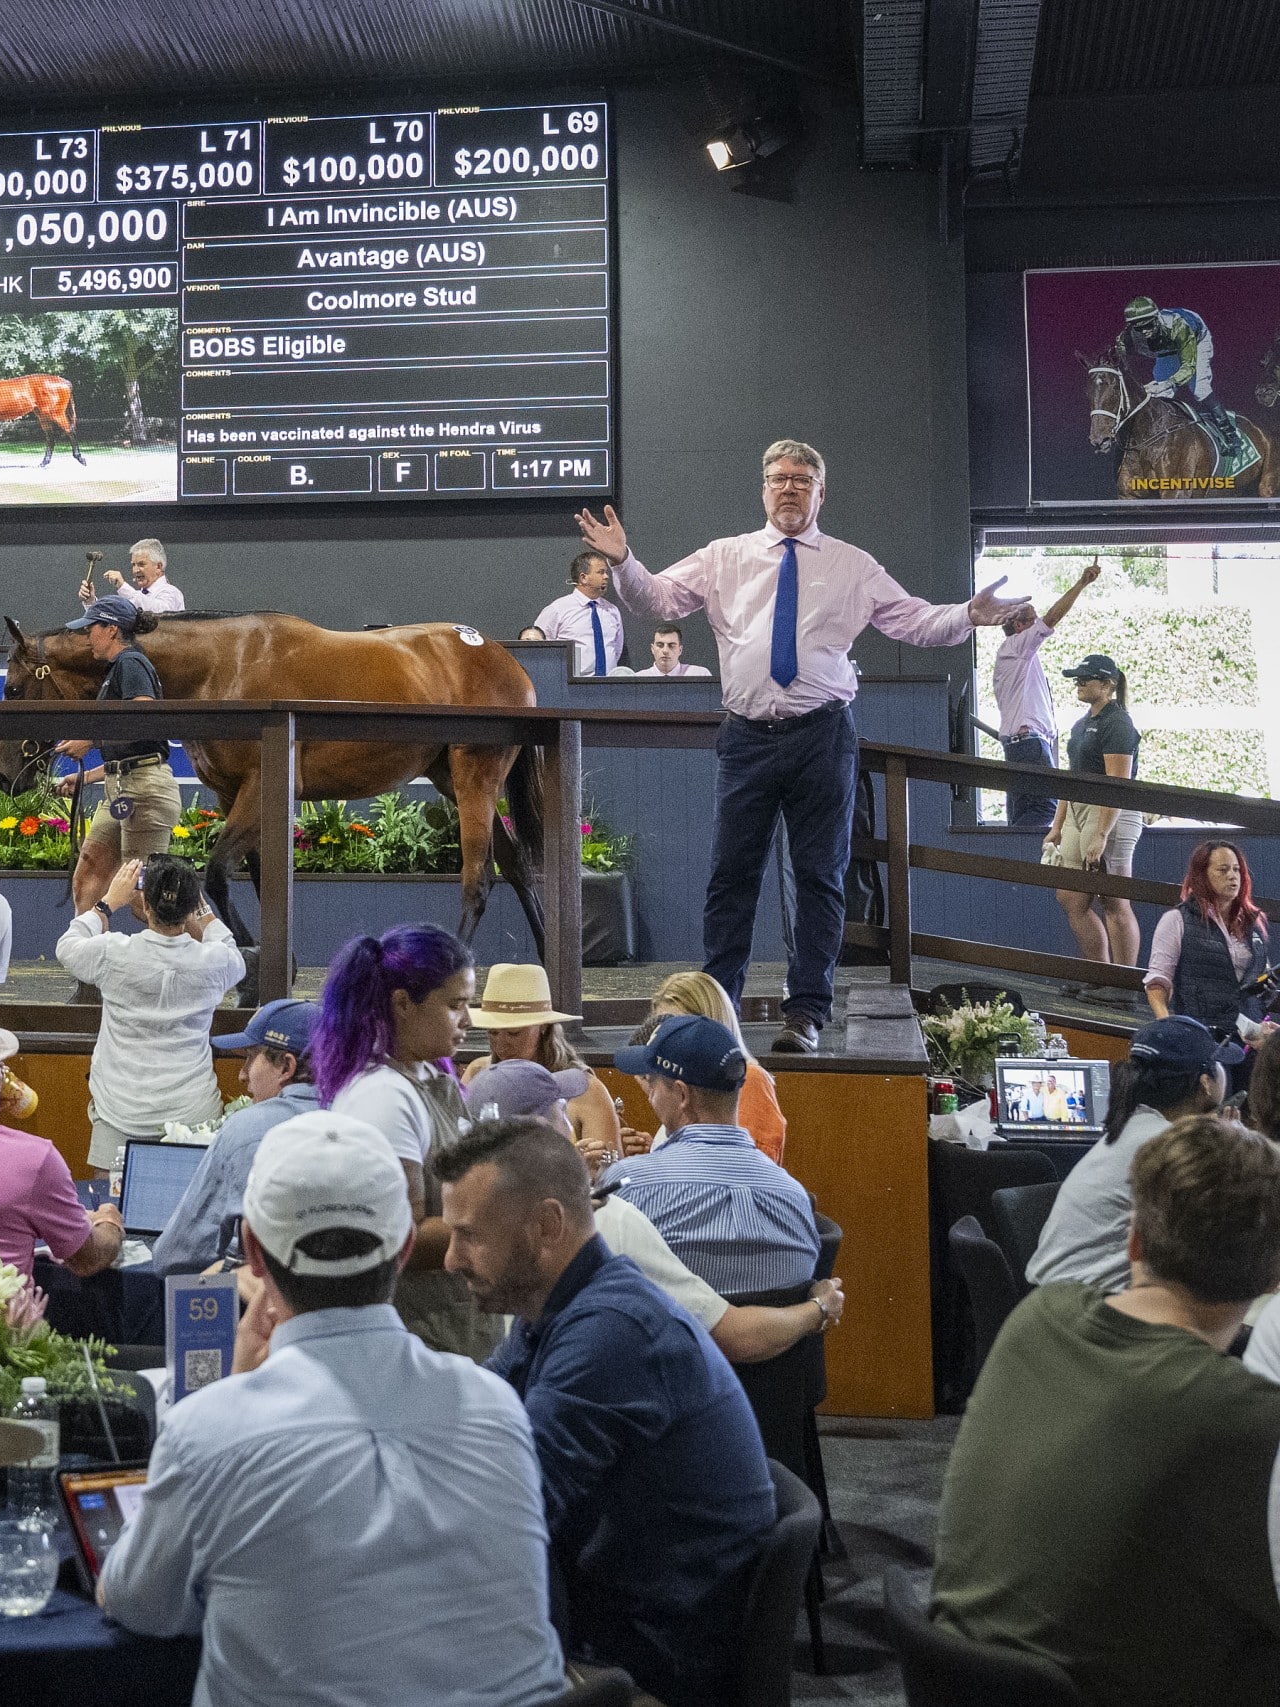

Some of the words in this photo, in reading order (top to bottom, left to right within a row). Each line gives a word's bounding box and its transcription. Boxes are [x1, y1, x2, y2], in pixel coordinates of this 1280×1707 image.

[369, 123, 386, 144] L
[393, 120, 424, 143] 70
[543, 113, 560, 135] L
[567, 111, 599, 134] 69
[36, 139, 52, 161] L
[58, 137, 88, 160] 73
[200, 131, 217, 153] L
[223, 129, 252, 151] 71
[282, 152, 424, 186] $100,000
[454, 143, 600, 178] $200,000
[116, 160, 254, 193] $375,000
[187, 199, 207, 207] SIRE
[267, 208, 274, 227] I
[280, 206, 320, 226] Am
[326, 200, 441, 225] Invincible
[447, 195, 518, 223] (AUS)
[186, 242, 206, 250] DAM
[297, 245, 410, 271] Avantage
[416, 241, 486, 268] (AUS)
[57, 267, 172, 294] 5,496,900
[186, 283, 221, 292] VENDOR
[307, 288, 419, 311] Coolmore
[423, 285, 477, 307] Stud
[186, 326, 232, 335] COMMENTS
[188, 336, 256, 359] BOBS
[262, 333, 347, 360] Eligible
[186, 369, 232, 377] COMMENTS
[185, 413, 231, 421] COMMENTS
[186, 429, 216, 443] Has
[220, 428, 257, 443] been
[261, 426, 345, 441] vaccinated
[348, 424, 406, 441] against
[409, 422, 435, 437] the
[438, 421, 496, 437] Hendra
[499, 420, 542, 436] Virus
[185, 456, 216, 464] ONLINE
[237, 455, 272, 463] COLOUR
[496, 448, 517, 456] TIME
[290, 464, 314, 486] B.
[395, 462, 412, 483] F
[510, 459, 554, 479] 1:17
[559, 458, 592, 477] PM
[1131, 477, 1235, 491] INCENTIVISE
[114, 800, 129, 815] 75
[656, 1055, 684, 1076] TOTI
[188, 1297, 219, 1321] 59
